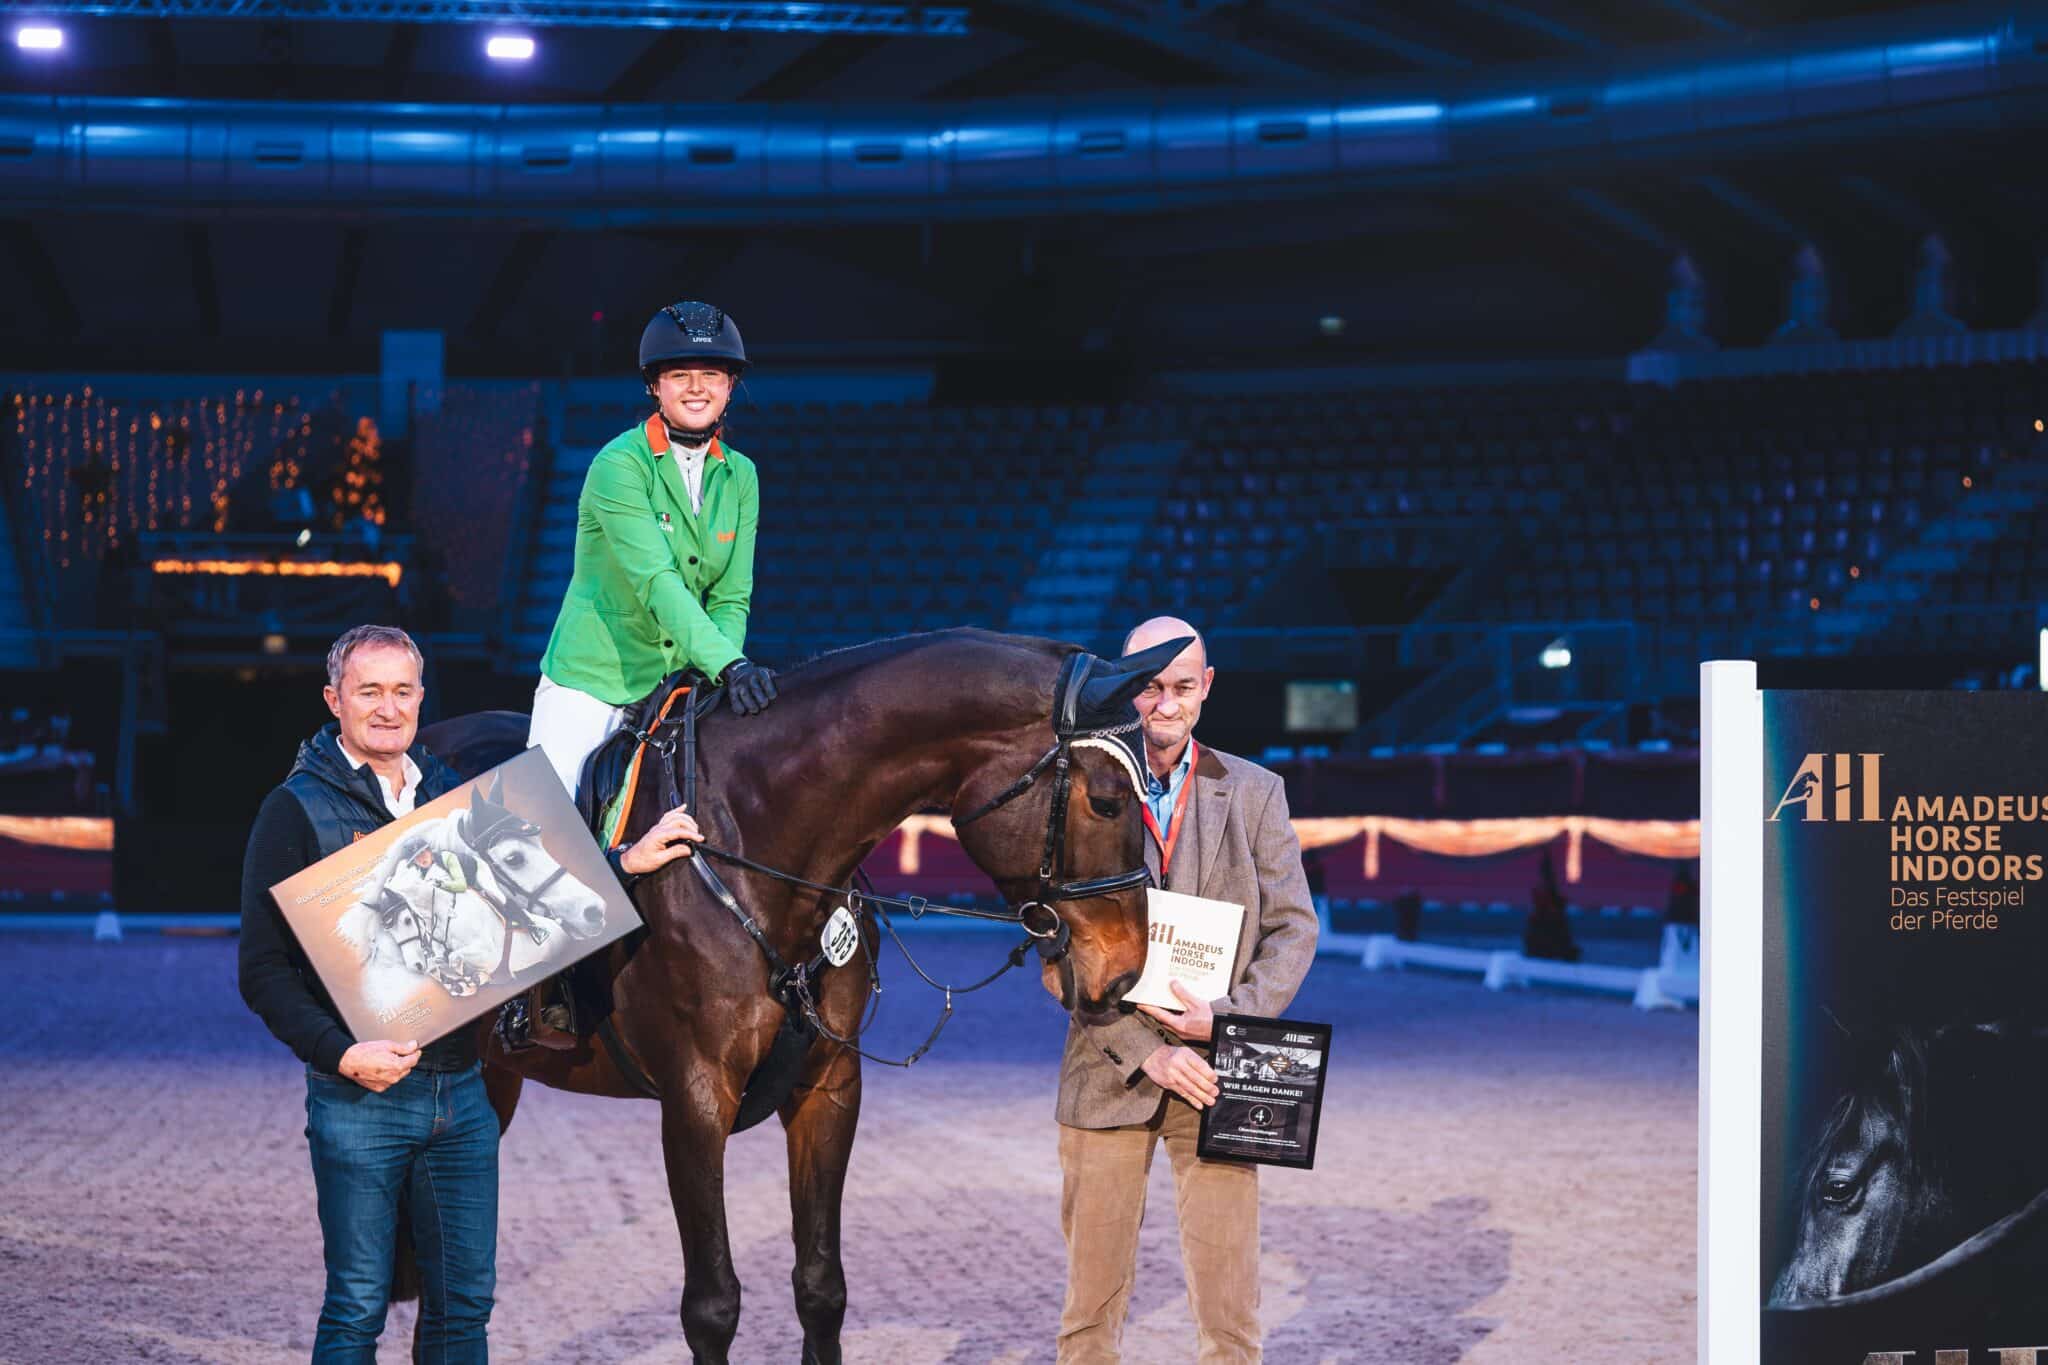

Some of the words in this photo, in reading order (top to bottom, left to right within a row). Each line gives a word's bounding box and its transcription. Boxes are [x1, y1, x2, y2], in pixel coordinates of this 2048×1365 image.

[1890, 825, 2001, 851] HORSE
[1890, 855, 2044, 881] INDOORS
[1890, 887, 1929, 907] Das
[1935, 885, 2024, 911] Festspiel
[1890, 909, 1926, 930] der
[1931, 908, 1999, 930] Pferde
[830, 921, 857, 960] 365
[1174, 938, 1224, 955] AMADEUS
[1172, 947, 1205, 960] HORSE
[1170, 955, 1216, 970] INDOORS
[1223, 1082, 1240, 1090] WIR
[1242, 1084, 1270, 1094] SAGEN
[1271, 1087, 1304, 1097] DANKE!
[1255, 1109, 1265, 1122] 4
